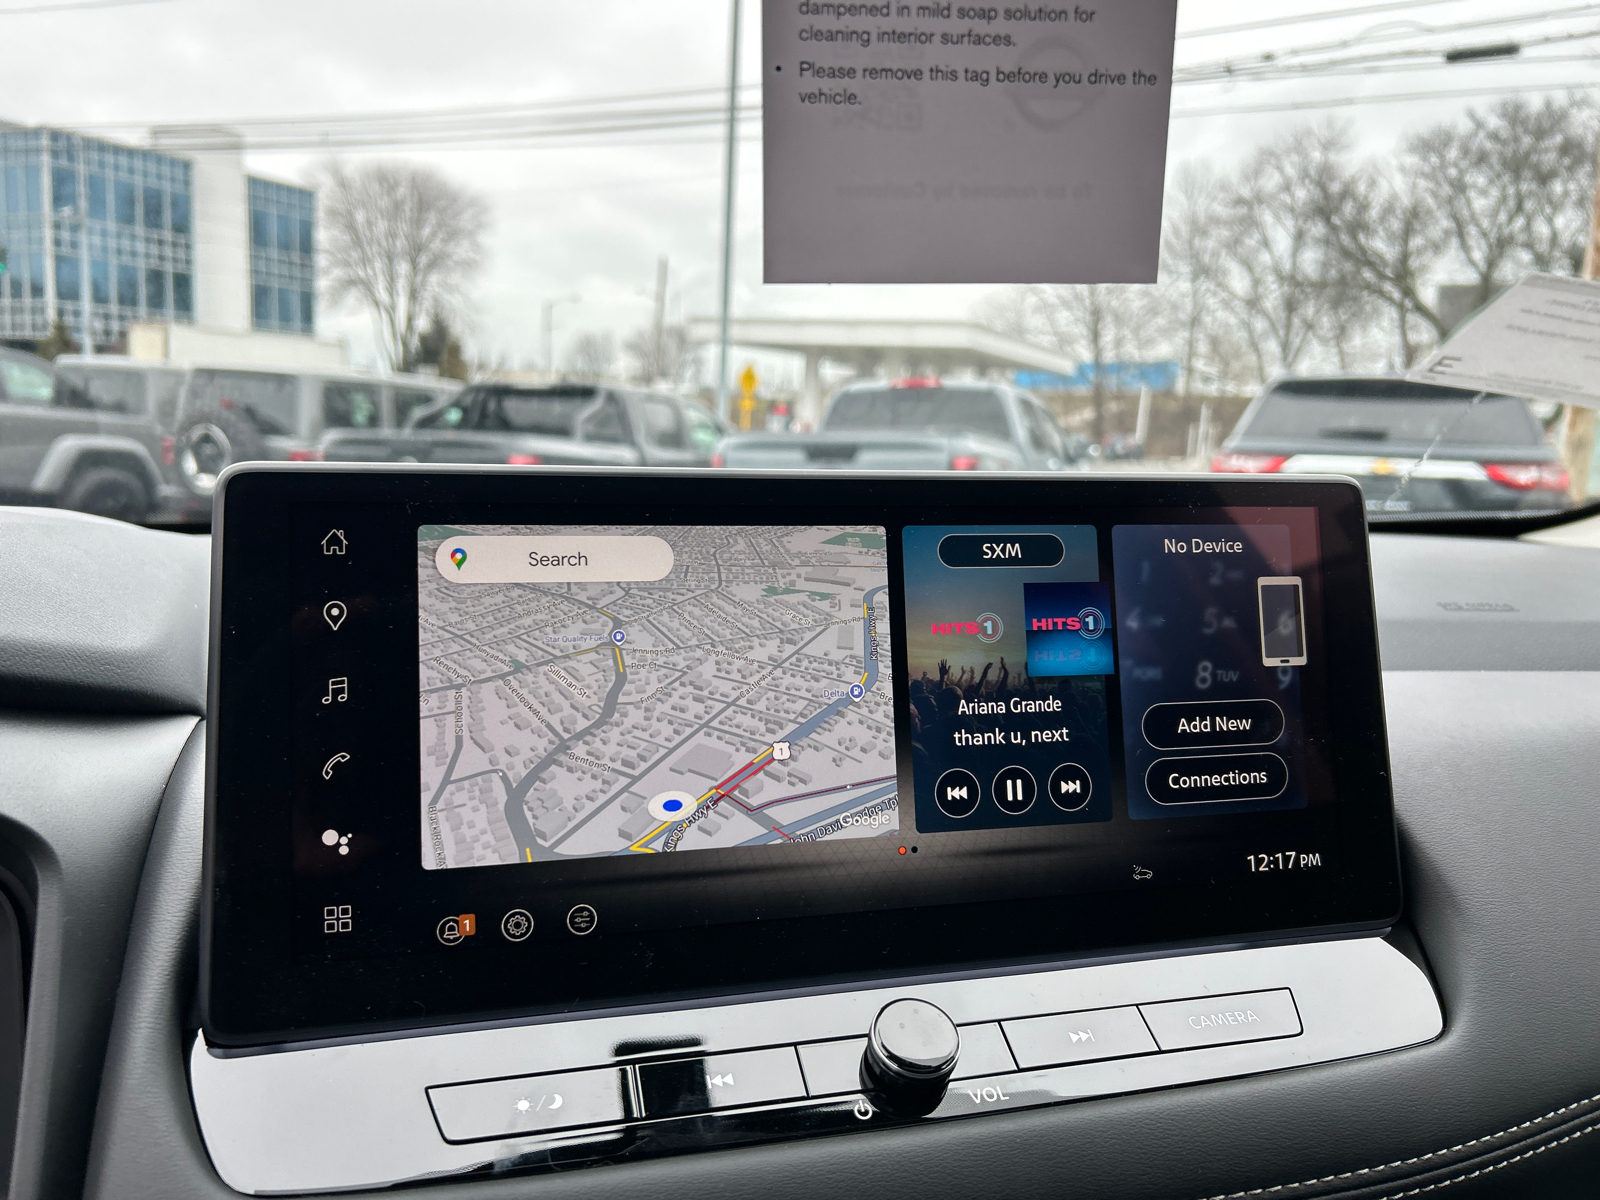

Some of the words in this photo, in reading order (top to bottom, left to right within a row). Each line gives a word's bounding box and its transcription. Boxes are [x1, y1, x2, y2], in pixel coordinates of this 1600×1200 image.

[798, 1, 890, 20] dampened
[897, 2, 910, 17] in
[916, 2, 950, 19] mild
[957, 7, 998, 25] soap
[1003, 5, 1069, 22] solution
[1074, 6, 1096, 23] for
[798, 24, 871, 47] cleaning
[876, 26, 935, 45] interior
[940, 28, 1017, 47] surfaces.
[799, 60, 857, 79] Please
[862, 67, 923, 81] remove
[929, 64, 959, 82] this
[964, 67, 990, 87] tag
[996, 66, 1048, 84] before
[1054, 71, 1082, 89] you
[1087, 68, 1127, 86] drive
[1132, 69, 1157, 86] the
[798, 88, 862, 106] vehicle.
[982, 543, 1022, 559] SXM
[1164, 538, 1187, 554] No
[1191, 538, 1243, 553] Device
[529, 551, 588, 567] Search
[517, 605, 551, 619] Andrassy
[552, 599, 566, 608] Ave
[544, 615, 575, 628] Rakoczy
[576, 608, 589, 618] Ave
[704, 604, 732, 624] Adelaide
[730, 621, 738, 630] St
[737, 600, 749, 614] May
[750, 608, 758, 617] St
[784, 608, 802, 624] Grace
[803, 618, 811, 626] St
[423, 617, 437, 628] Ave
[678, 612, 698, 630] Prince
[698, 627, 706, 636] St
[931, 621, 980, 635] HITS
[984, 620, 993, 635] 1
[1032, 617, 1081, 631] HITS
[1085, 615, 1094, 630] 1
[545, 636, 560, 644] Star
[562, 635, 588, 645] Quality
[590, 634, 609, 642] Fuels
[870, 636, 879, 660] Kings
[631, 647, 664, 656] Jennings
[702, 646, 744, 660] Longfellow
[743, 656, 757, 665] Ave
[433, 656, 463, 680] Renchy
[462, 674, 472, 685] St
[1194, 660, 1213, 689] 8
[1216, 670, 1239, 682] TUV
[547, 664, 578, 691] Silliman
[577, 687, 587, 698] St
[740, 680, 762, 698] Castle
[761, 669, 775, 682] Ave
[455, 690, 463, 701] St
[503, 678, 535, 711] Overlook
[531, 708, 547, 725] Ave
[640, 692, 657, 705] Finn
[656, 685, 666, 695] St
[823, 690, 845, 698] Delta
[957, 699, 1006, 716] Ariana
[1010, 696, 1062, 714] Grande
[455, 702, 463, 735] School
[1177, 716, 1212, 734] Add
[1216, 716, 1252, 733] New
[953, 728, 1005, 747] thank
[1010, 732, 1027, 747] u,
[1031, 727, 1069, 743] next
[568, 752, 600, 769] Benton
[600, 763, 611, 773] St
[1168, 769, 1268, 790] Connections
[428, 805, 441, 832] Black
[685, 805, 709, 827] Hwy
[706, 797, 718, 810] E
[840, 812, 890, 829] Google
[433, 833, 445, 858] Rock
[1247, 852, 1296, 873] 12:17
[1300, 852, 1322, 869] PM
[463, 919, 471, 932] 1
[1188, 1009, 1260, 1030] CAMERA
[968, 1086, 1010, 1104] VOL
